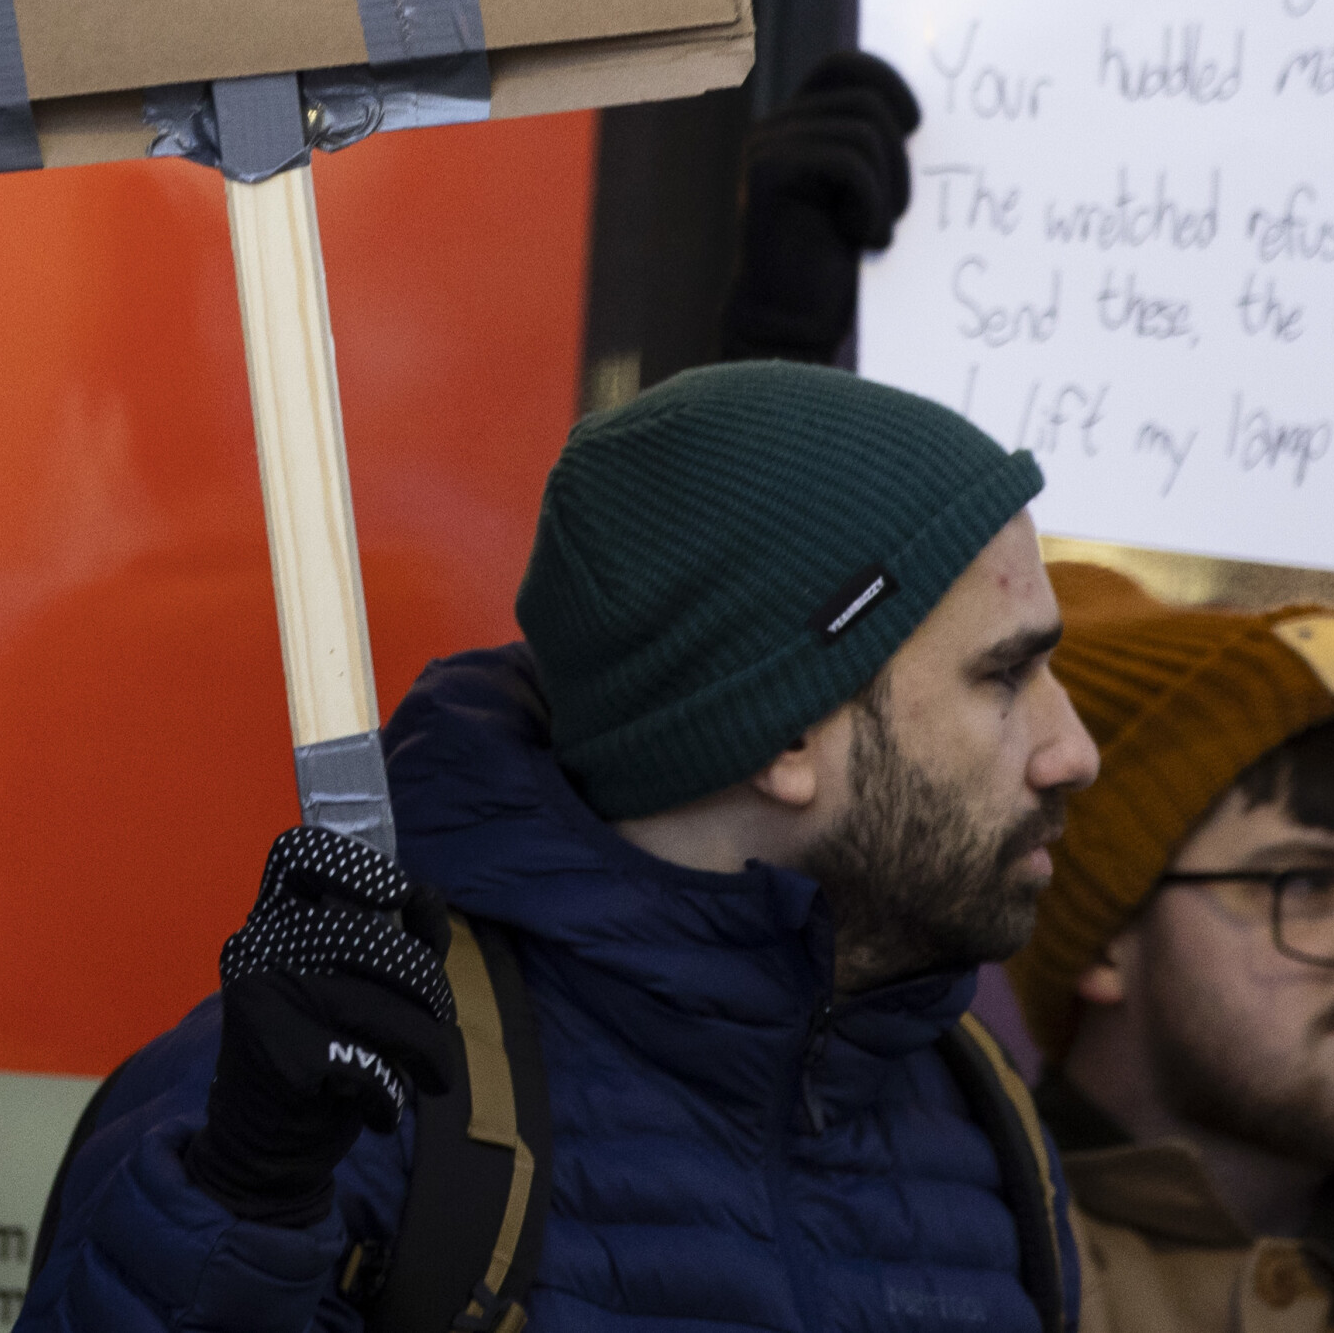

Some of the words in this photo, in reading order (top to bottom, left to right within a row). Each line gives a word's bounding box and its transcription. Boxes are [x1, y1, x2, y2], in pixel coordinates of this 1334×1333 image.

[928, 17, 1053, 120] Your
[1097, 21, 1247, 104] huddled
[921, 161, 1023, 236] The
[1044, 164, 1223, 251] wretched
[950, 253, 1063, 349] Send
[1235, 269, 1305, 342] the
[1017, 375, 1112, 460] lift
[1134, 417, 1199, 499] my
[1226, 389, 1334, 489] lamp
[327, 1040, 407, 1125] ATHAN
